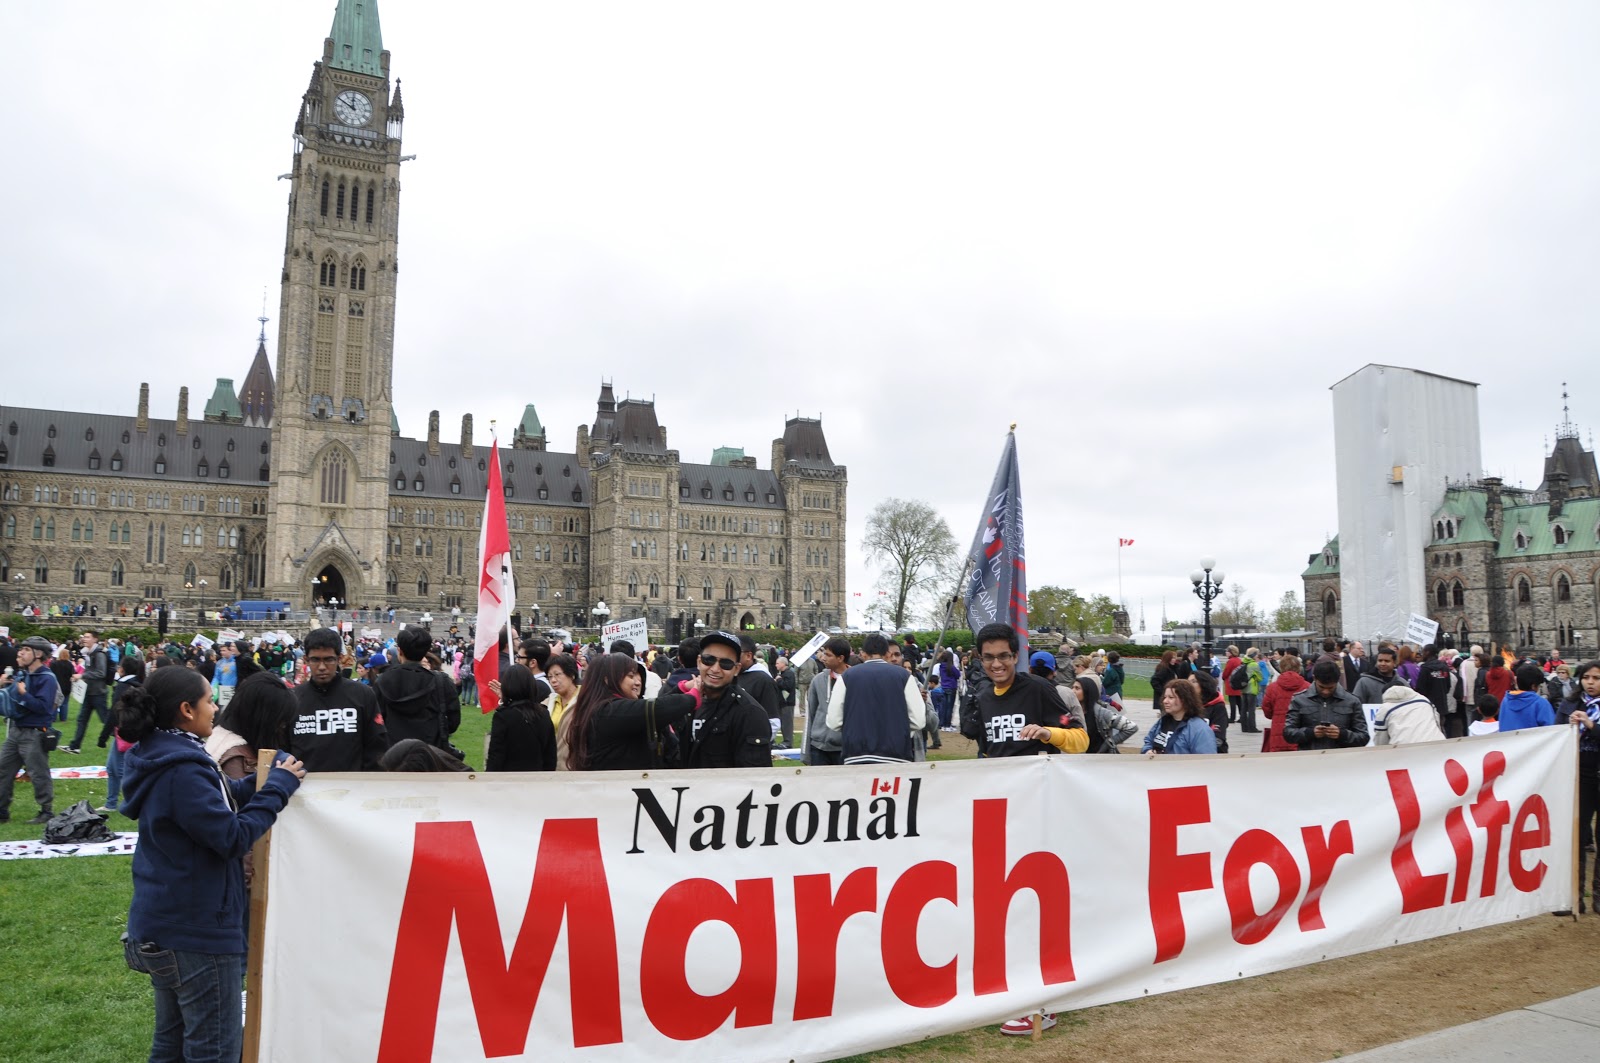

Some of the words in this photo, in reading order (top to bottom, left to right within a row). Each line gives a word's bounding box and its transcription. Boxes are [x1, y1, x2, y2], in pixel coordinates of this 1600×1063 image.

[605, 625, 620, 635] LIFE
[631, 622, 645, 630] FIRST
[316, 708, 357, 722] PRO
[991, 713, 1026, 730] PRO
[316, 720, 357, 735] LIFE
[626, 777, 921, 855] National
[377, 797, 1077, 1063] March
[1147, 785, 1354, 964] For
[1386, 750, 1552, 914] Life
